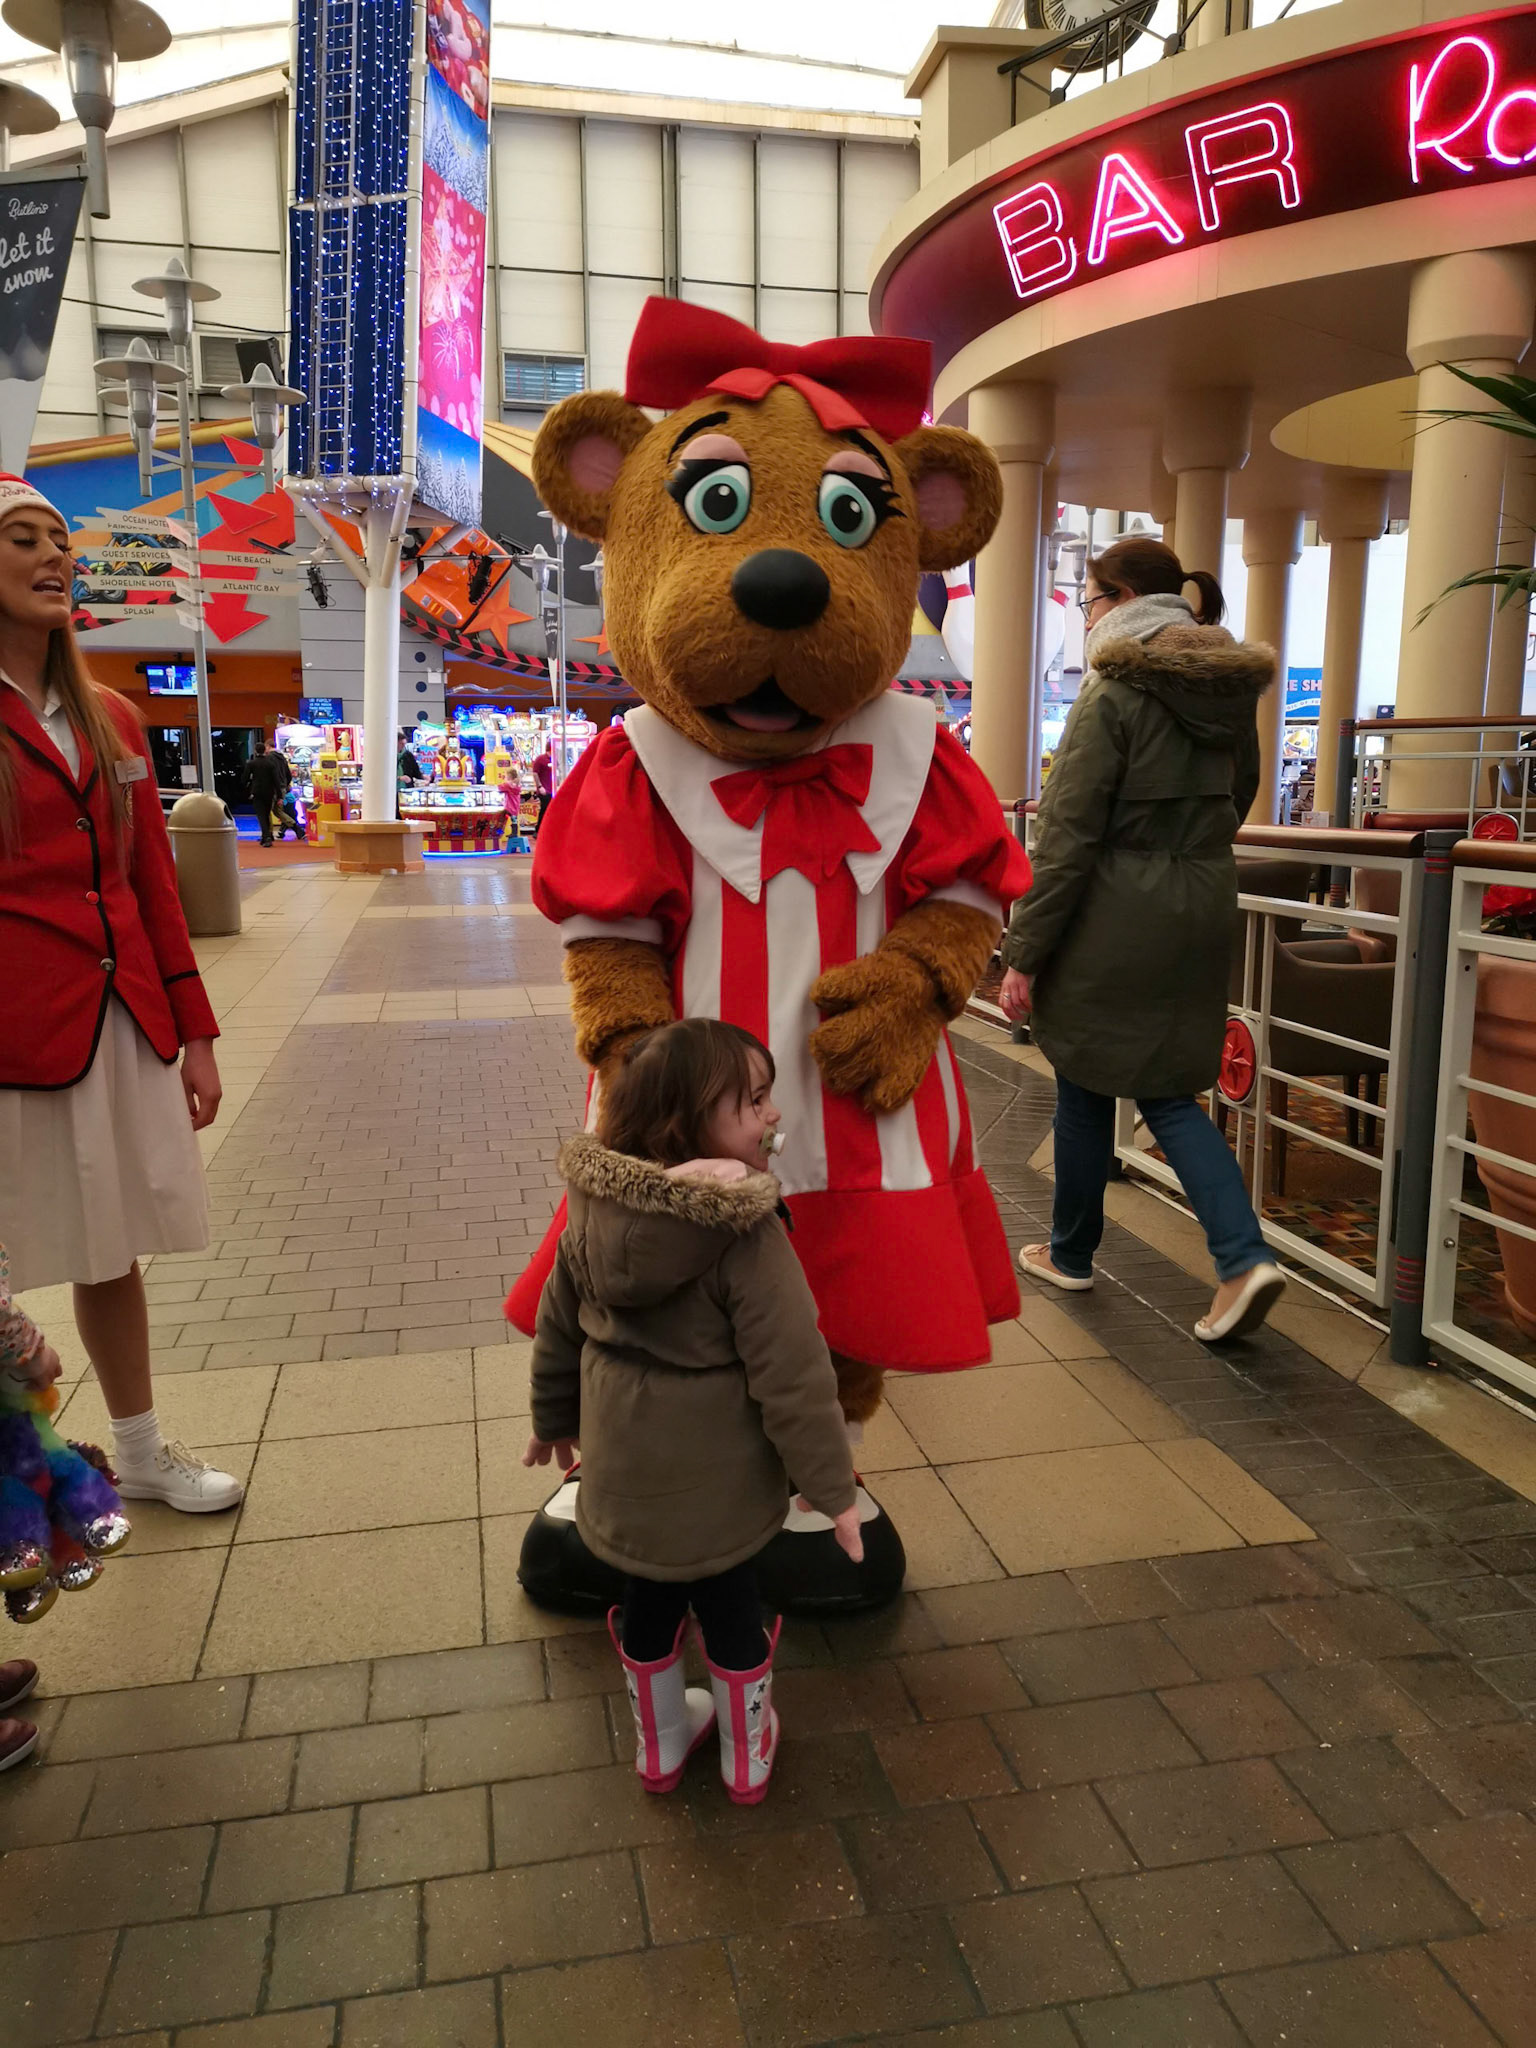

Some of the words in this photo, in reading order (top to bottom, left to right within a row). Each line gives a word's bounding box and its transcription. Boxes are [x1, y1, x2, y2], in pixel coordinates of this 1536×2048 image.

[992, 102, 1300, 297] BAR
[9, 198, 49, 220] Butlin's
[0, 231, 32, 269] let
[36, 226, 55, 256] it
[3, 266, 54, 294] snow
[122, 514, 147, 525] OCEAN
[101, 550, 129, 558] GUEST
[131, 550, 171, 559] SERVICES
[226, 554, 242, 563] THE
[244, 556, 272, 565] BEACH
[99, 579, 147, 587] SHORELINE
[148, 580, 176, 588] HOTEL
[222, 582, 262, 592] ATLANTIC
[263, 584, 280, 592] BAY
[123, 607, 155, 615] SPLASH
